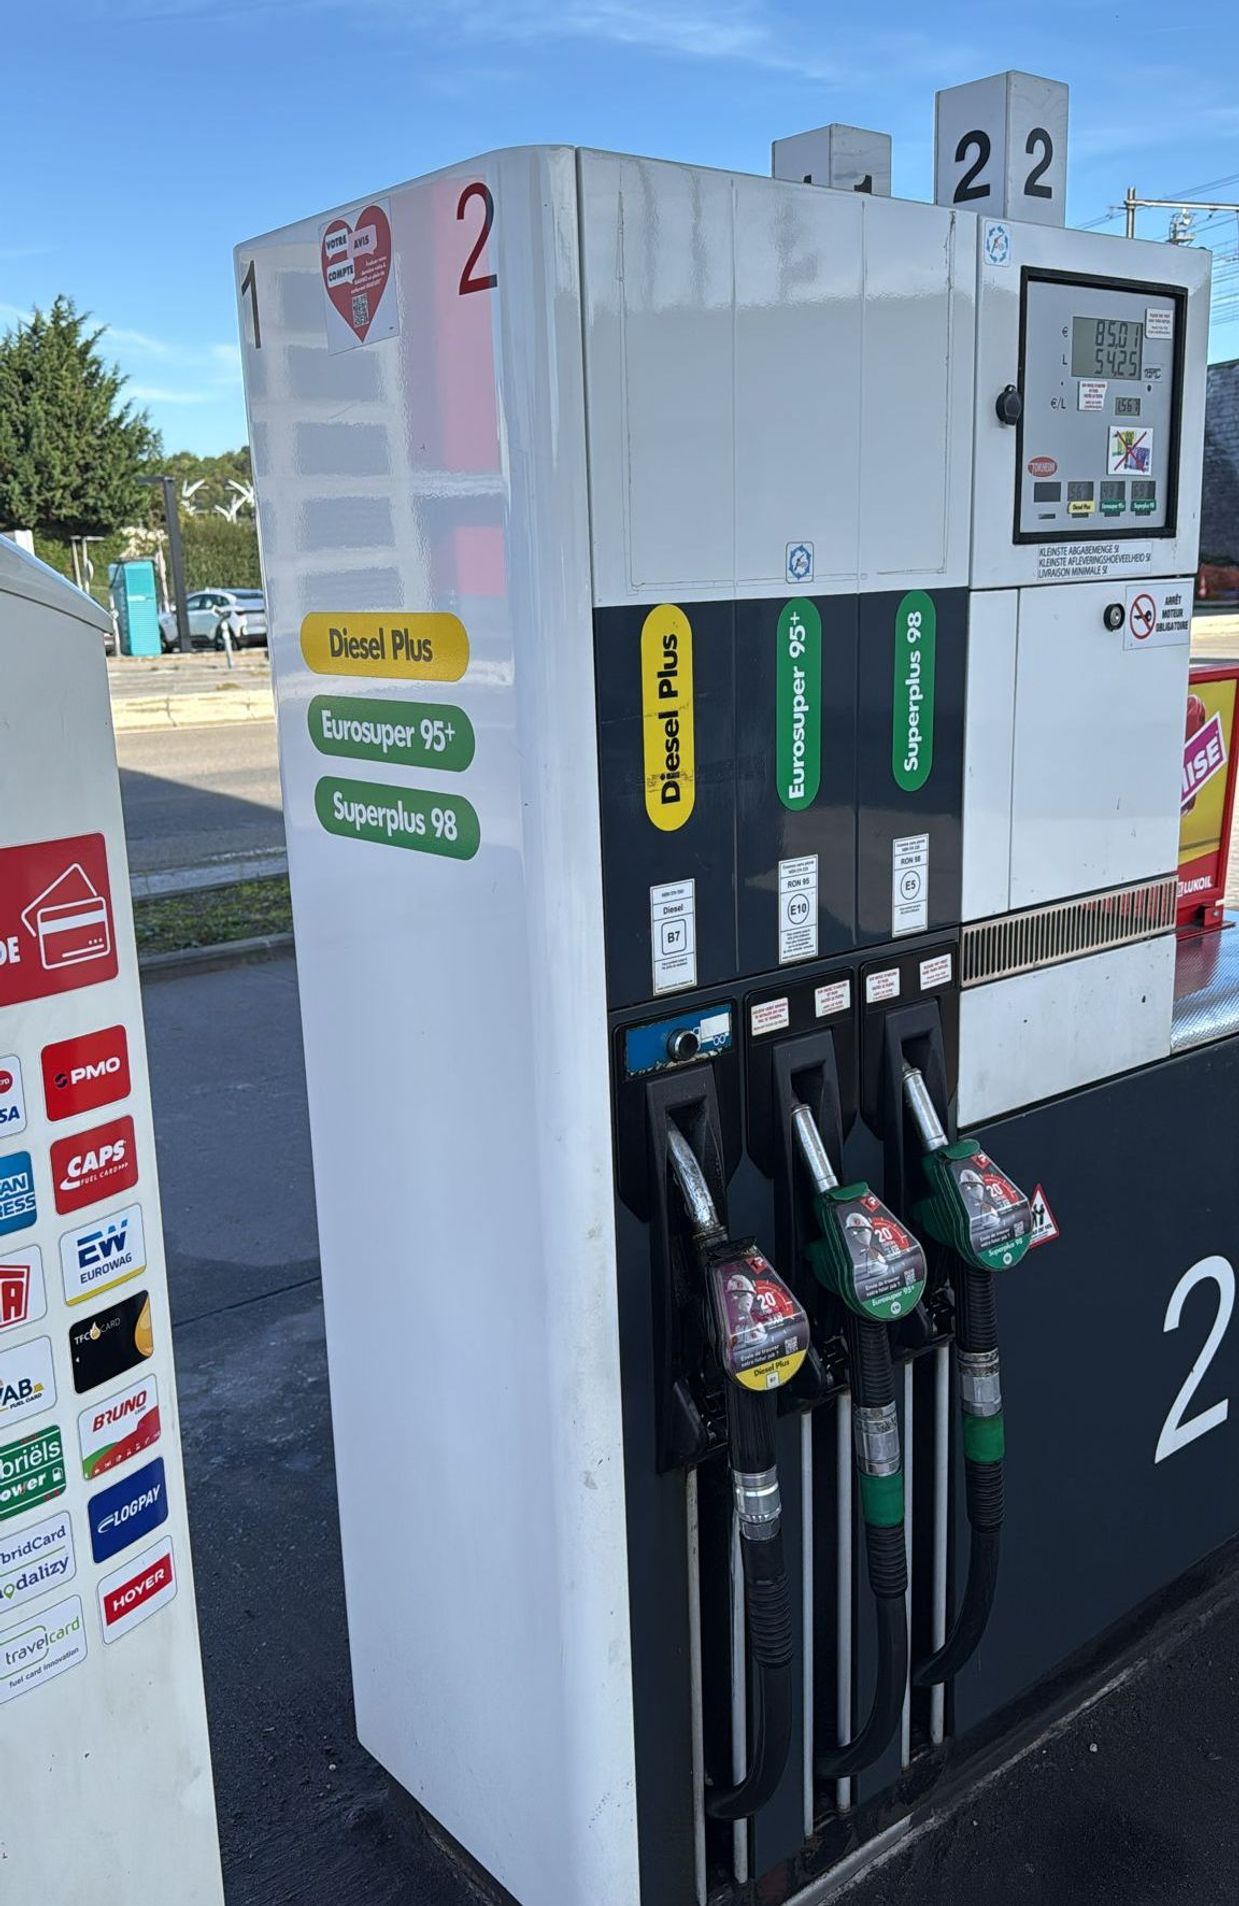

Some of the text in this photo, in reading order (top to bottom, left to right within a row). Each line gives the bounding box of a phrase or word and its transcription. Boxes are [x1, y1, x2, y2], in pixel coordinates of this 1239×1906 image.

[953, 130, 991, 203] 2
[1024, 127, 1053, 199] 2
[326, 235, 369, 250] VOTRE AVIS
[456, 182, 498, 296] 2
[328, 265, 354, 281] COMPTE
[241, 260, 261, 348] 1
[1039, 557, 1067, 568] KLEINSTE
[1040, 547, 1067, 557] KLEINSTE
[1068, 545, 1112, 556] ABGABEMENGE
[1039, 568, 1070, 578] LIVRAISON
[1072, 567, 1101, 577] MINIMALE
[1156, 621, 1188, 632] OBLIGATOIRE
[1162, 608, 1183, 619] MOTEUR
[329, 627, 433, 662] Diesel Plus
[904, 611, 923, 771] Superplus 98
[321, 710, 455, 753] Eurosuper 95+
[657, 634, 681, 804] Diesel Plus
[788, 666, 809, 799] Eurosuper
[1184, 736, 1220, 793] ISE
[333, 791, 458, 841] Superplus 98
[788, 879, 801, 888] RON
[905, 880, 916, 890] E5
[1184, 876, 1212, 894] LUKOIL
[663, 904, 684, 915] Diesel
[790, 903, 807, 915] E10
[667, 931, 681, 943] B7
[71, 1057, 121, 1085] PMO
[67, 1140, 126, 1178] CAPS
[80, 1167, 118, 1186] FUEL CARD
[986, 1183, 1003, 1198] 20
[77, 1219, 128, 1268] EW
[875, 1227, 893, 1243] 20
[80, 1253, 132, 1284] EUROWAG
[757, 1292, 776, 1310] 20
[74, 1318, 121, 1345] TFC CARD
[754, 1360, 790, 1376] Diesel Plus
[1155, 1255, 1235, 1464] 2
[10, 1392, 42, 1409] FUEL CARD
[93, 1390, 147, 1432] BRUNO
[114, 1485, 161, 1526] LOGPAY
[113, 1568, 165, 1612] HOYER
[6, 1616, 80, 1665] travelcard
[9, 1648, 79, 1688] fuel card innovation
